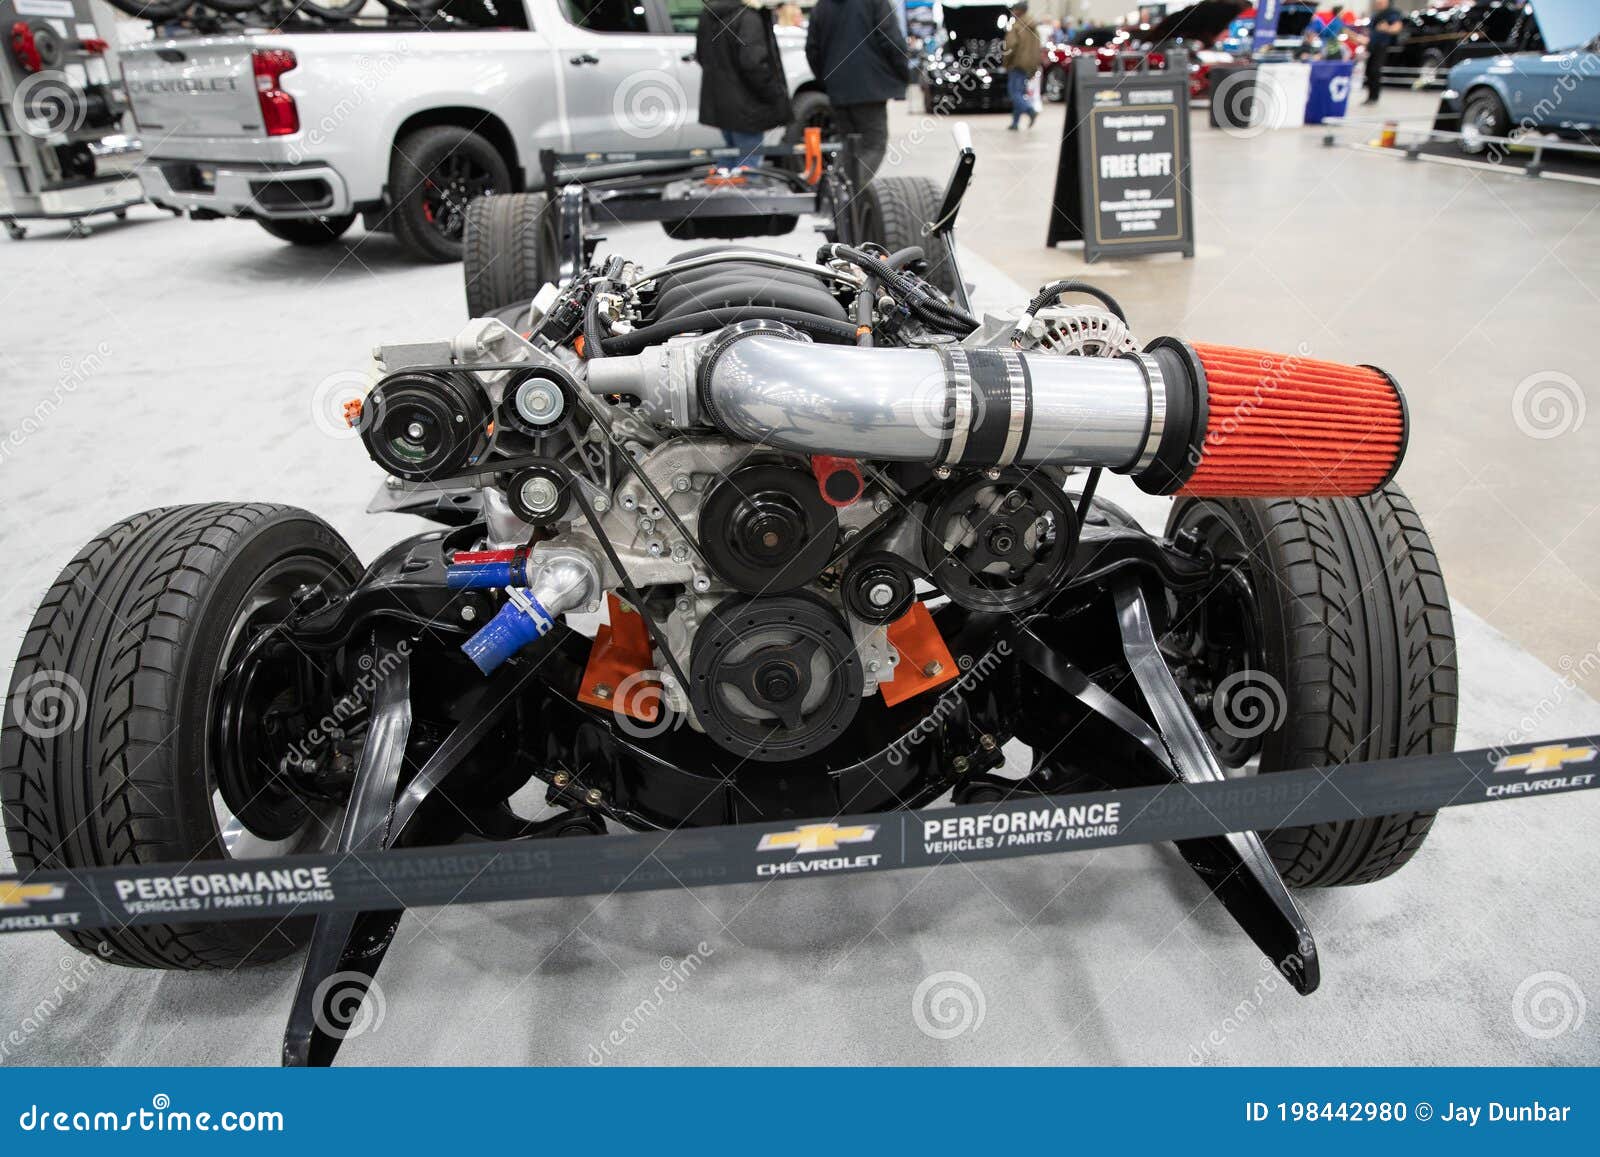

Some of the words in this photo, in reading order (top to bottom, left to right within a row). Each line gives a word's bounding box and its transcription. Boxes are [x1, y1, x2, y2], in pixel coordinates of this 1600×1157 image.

[129, 78, 239, 94] CHEVROLET
[1101, 154, 1137, 178] FREE
[1138, 153, 1171, 177] GIFT
[1486, 774, 1596, 796] CHEVROLET
[923, 802, 1121, 841] PERFORMANCE
[923, 837, 994, 855] VEHICLES
[1007, 830, 1053, 846] PARTS
[1066, 823, 1119, 841] RACING
[756, 854, 882, 876] CHEVROLET
[115, 867, 332, 900] PERFORMANCE
[123, 896, 201, 914] VEHICLES
[214, 892, 264, 909] PARTS
[276, 889, 335, 905] RACING
